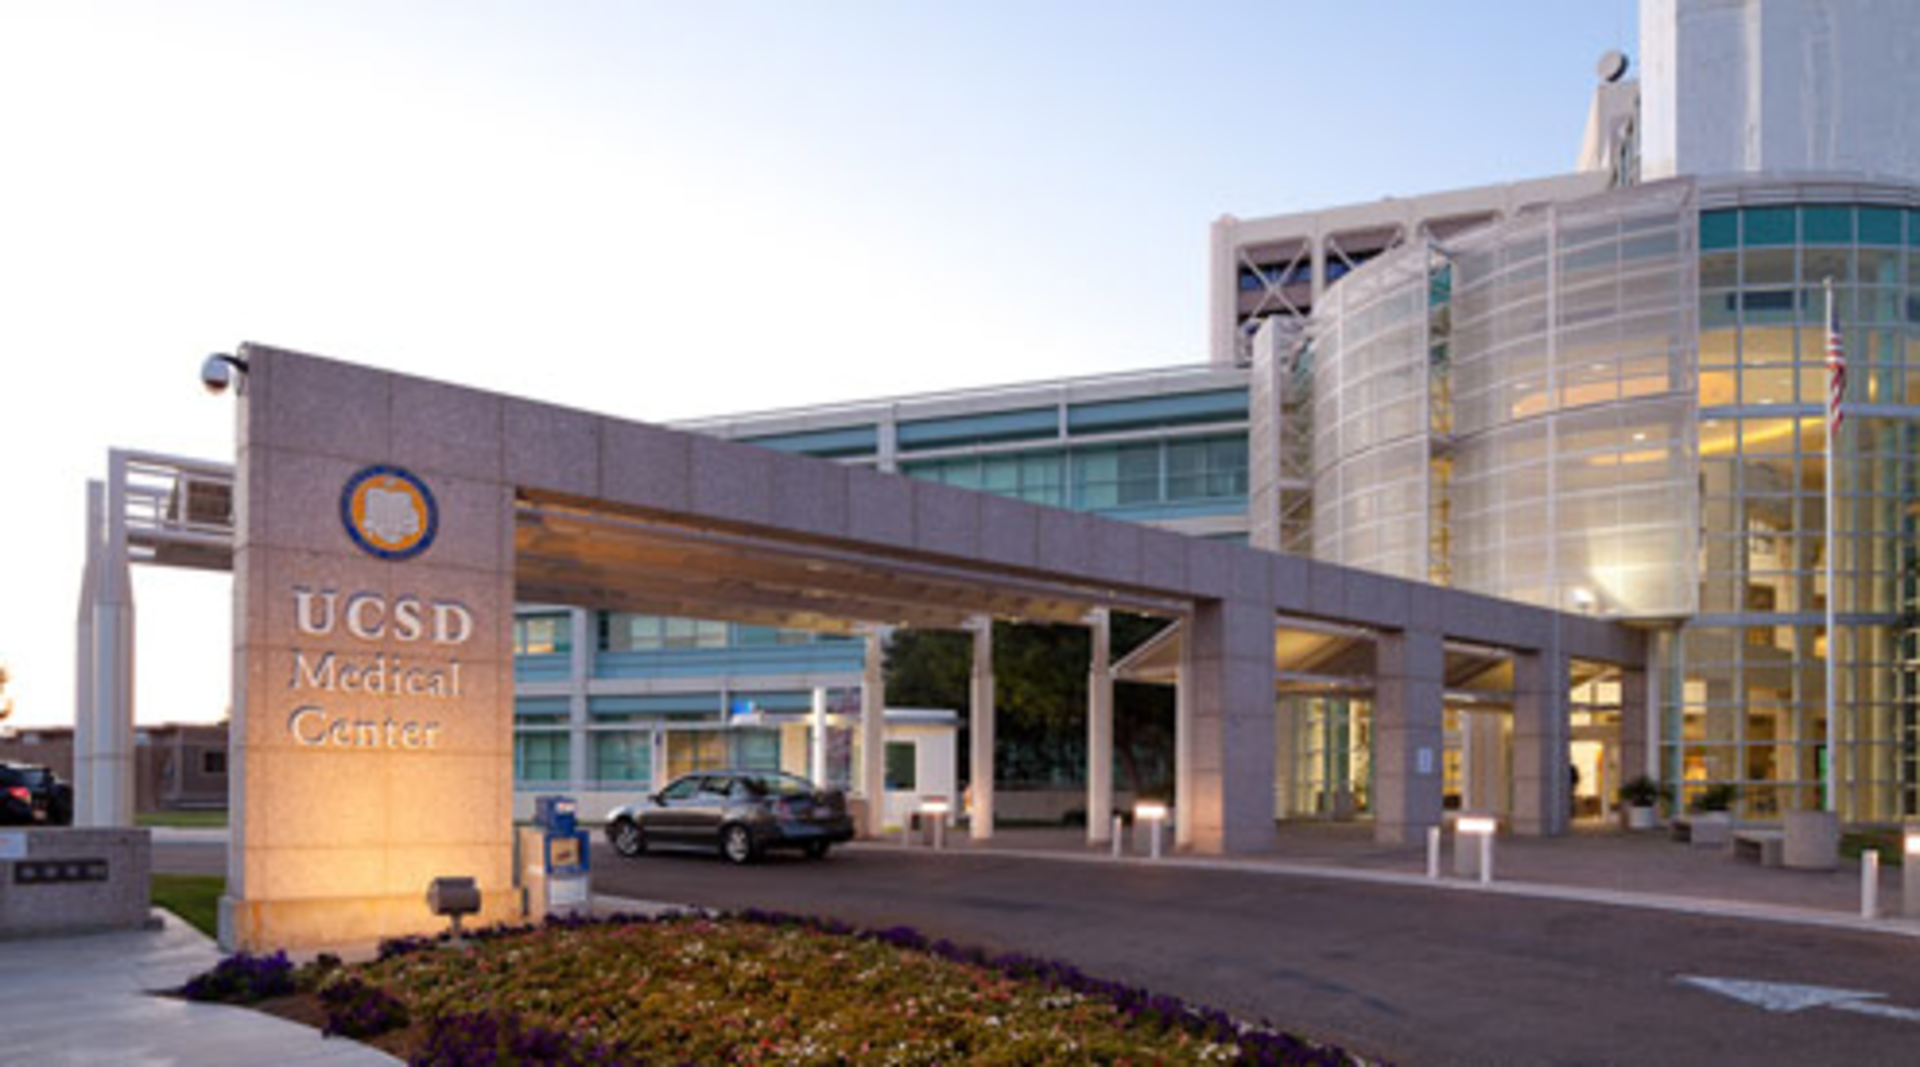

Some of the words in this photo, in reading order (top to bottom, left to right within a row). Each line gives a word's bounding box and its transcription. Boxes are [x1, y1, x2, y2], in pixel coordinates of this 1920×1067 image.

[293, 587, 474, 645] UCSD
[289, 649, 462, 697] Medical
[288, 704, 440, 748] Center
